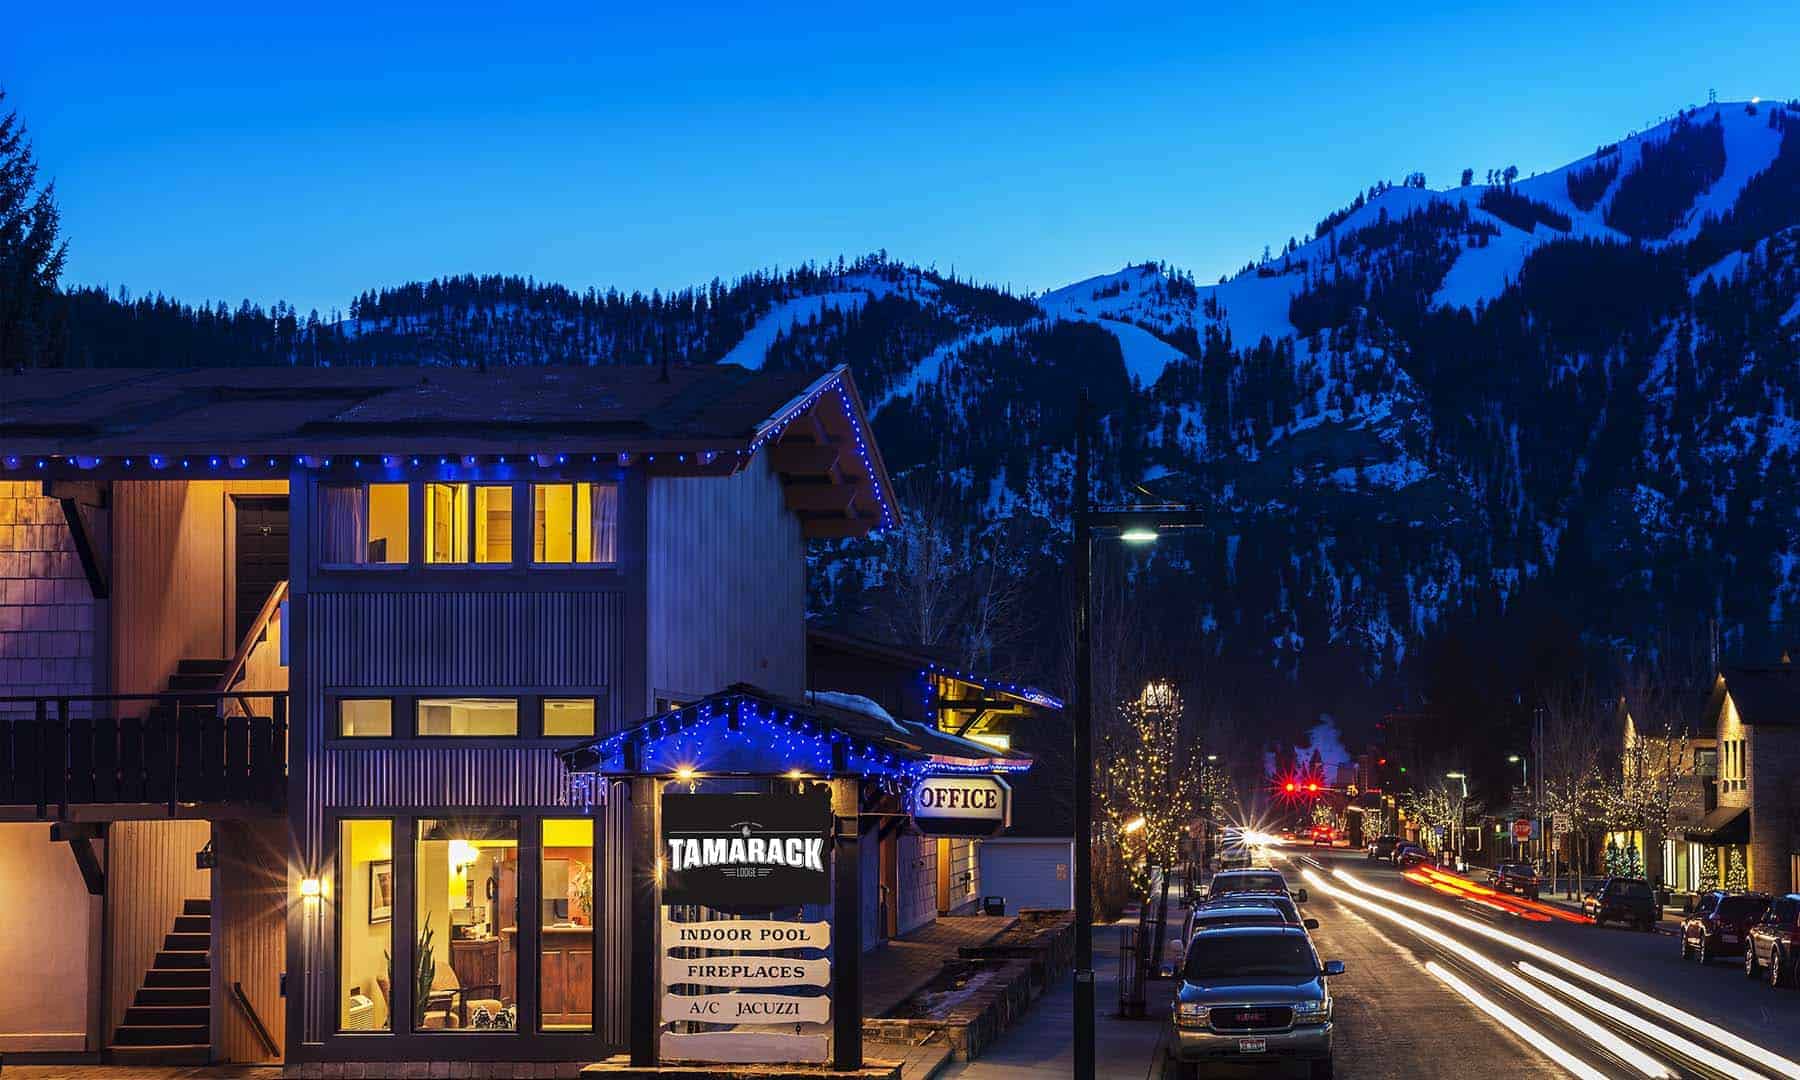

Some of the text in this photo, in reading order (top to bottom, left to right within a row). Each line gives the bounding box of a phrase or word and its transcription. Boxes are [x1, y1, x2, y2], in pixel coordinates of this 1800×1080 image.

[920, 787, 998, 809] OFFICE
[1554, 823, 1567, 831] 25
[668, 838, 824, 872] TAMARACK
[736, 867, 757, 877] LODGE
[680, 928, 811, 941] INDOOR POOL
[688, 965, 805, 978] FIREPLACES
[690, 1001, 800, 1016] A/C JACUZZI
